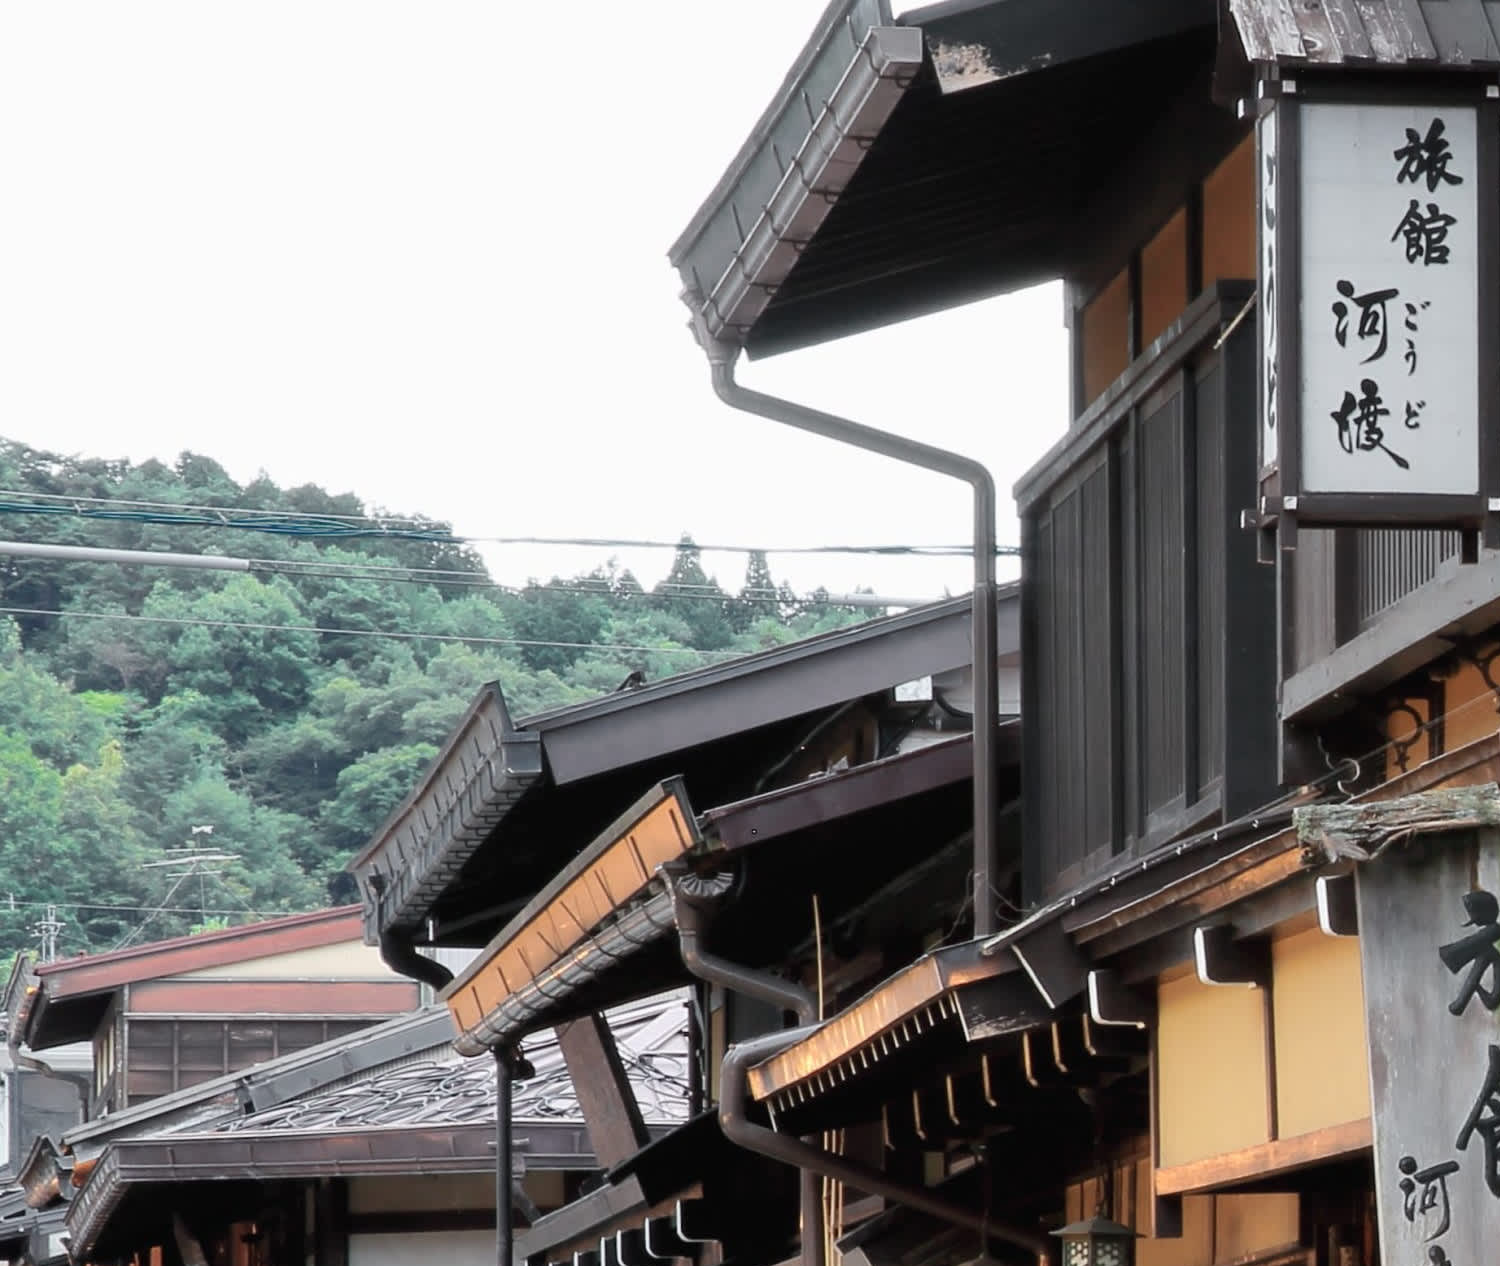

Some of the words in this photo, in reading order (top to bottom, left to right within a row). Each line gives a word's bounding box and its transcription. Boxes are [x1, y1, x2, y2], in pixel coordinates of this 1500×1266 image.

[1391, 118, 1464, 267] 旅館
[1404, 300, 1432, 430] ごうど
